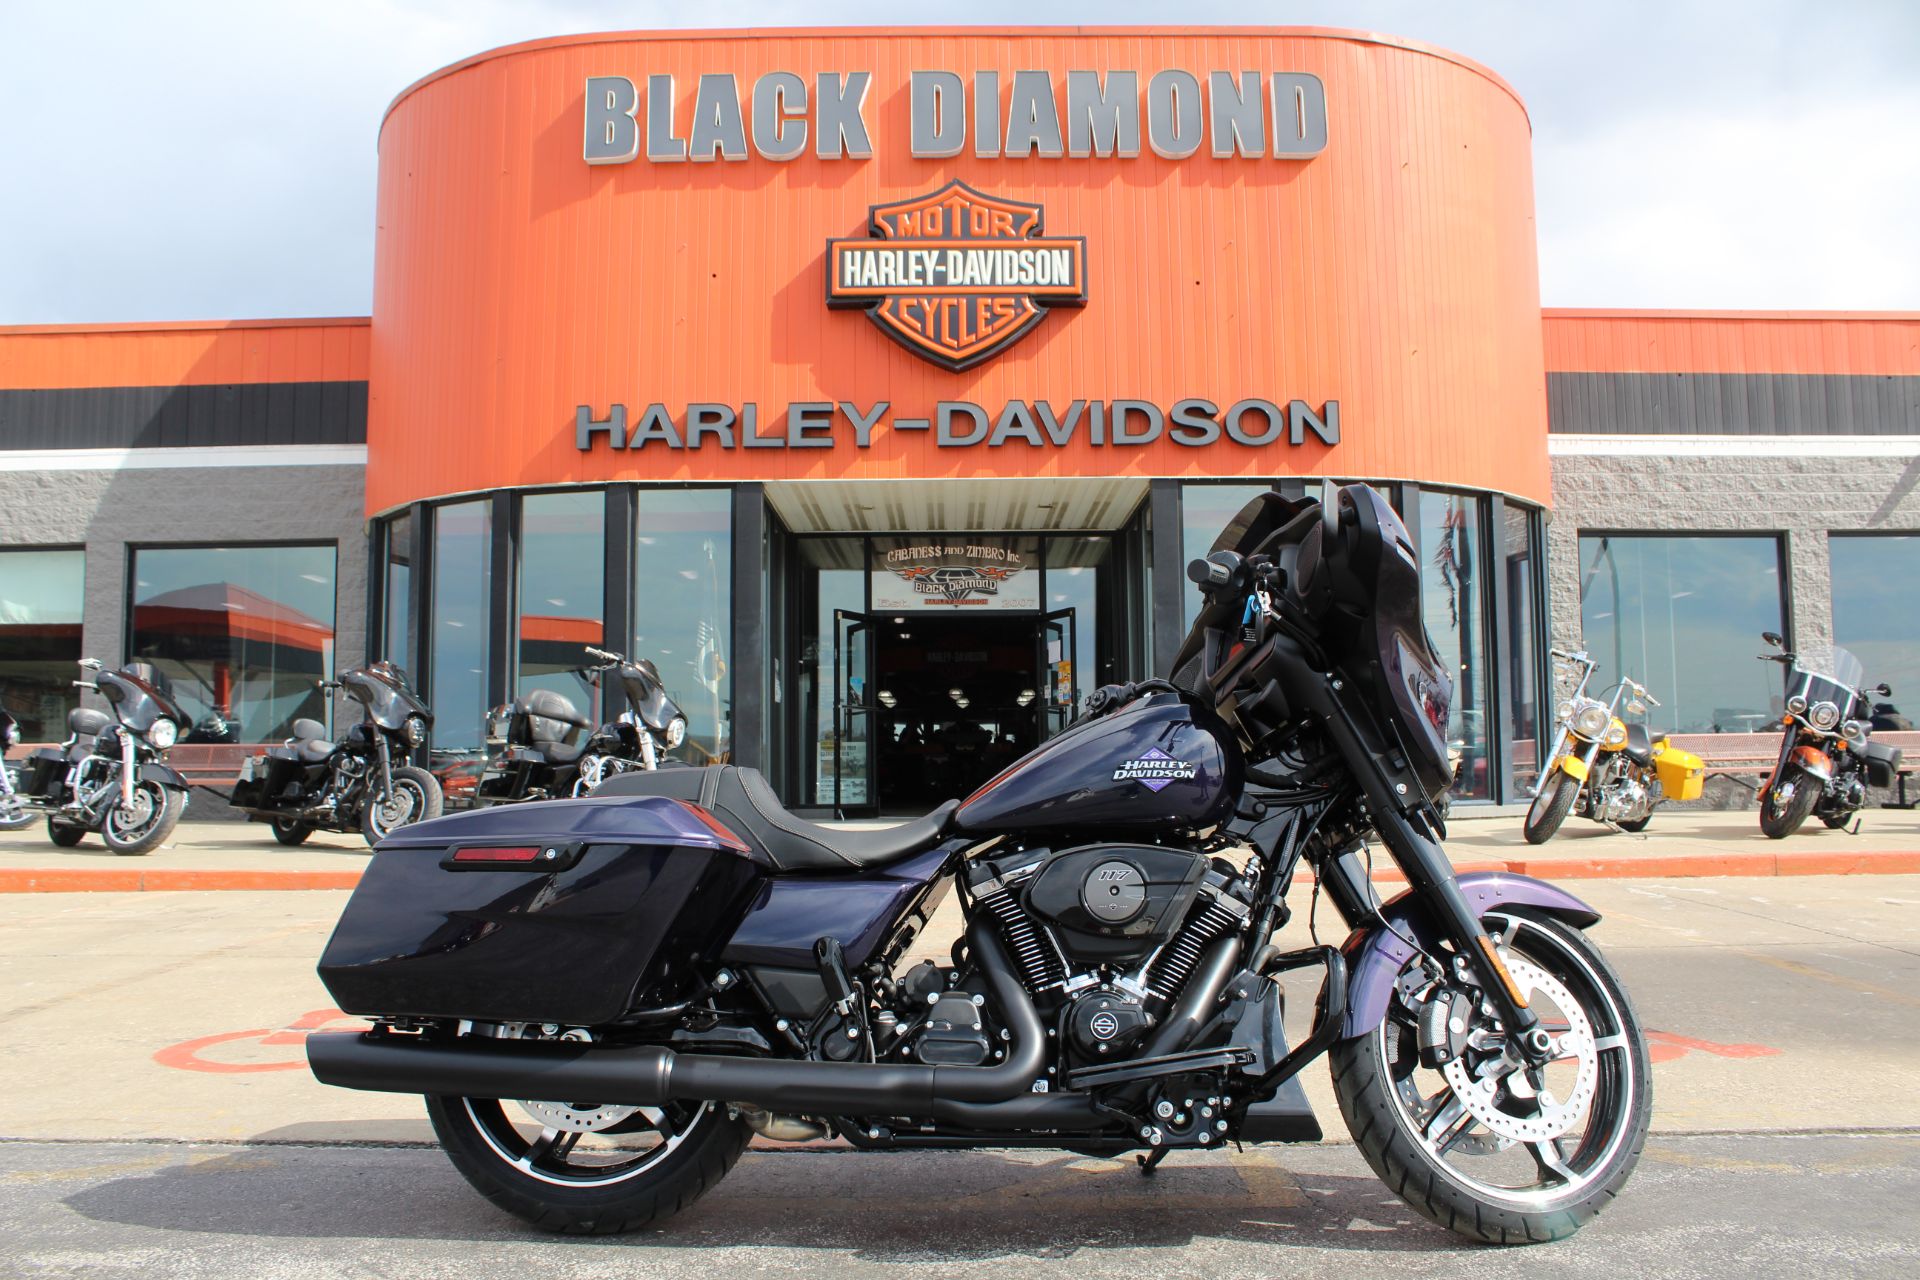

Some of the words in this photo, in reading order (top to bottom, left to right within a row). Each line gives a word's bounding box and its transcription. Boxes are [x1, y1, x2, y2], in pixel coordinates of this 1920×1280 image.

[583, 71, 873, 165] BLACK
[910, 70, 1328, 160] DIAMOND
[896, 195, 1016, 237] MOTOR
[844, 249, 1070, 286] HARLEY-DAVIDSON
[899, 297, 1015, 349] CYCLES
[576, 400, 1340, 450] HARLEY-DAVIDSON
[887, 545, 942, 562] CABANESS
[966, 545, 1005, 561] ZIMBRO
[1007, 549, 1021, 563] Inc.
[1113, 769, 1196, 780] DAVIDSON
[1120, 760, 1192, 769] HARLEY-
[1098, 869, 1133, 881] 117
